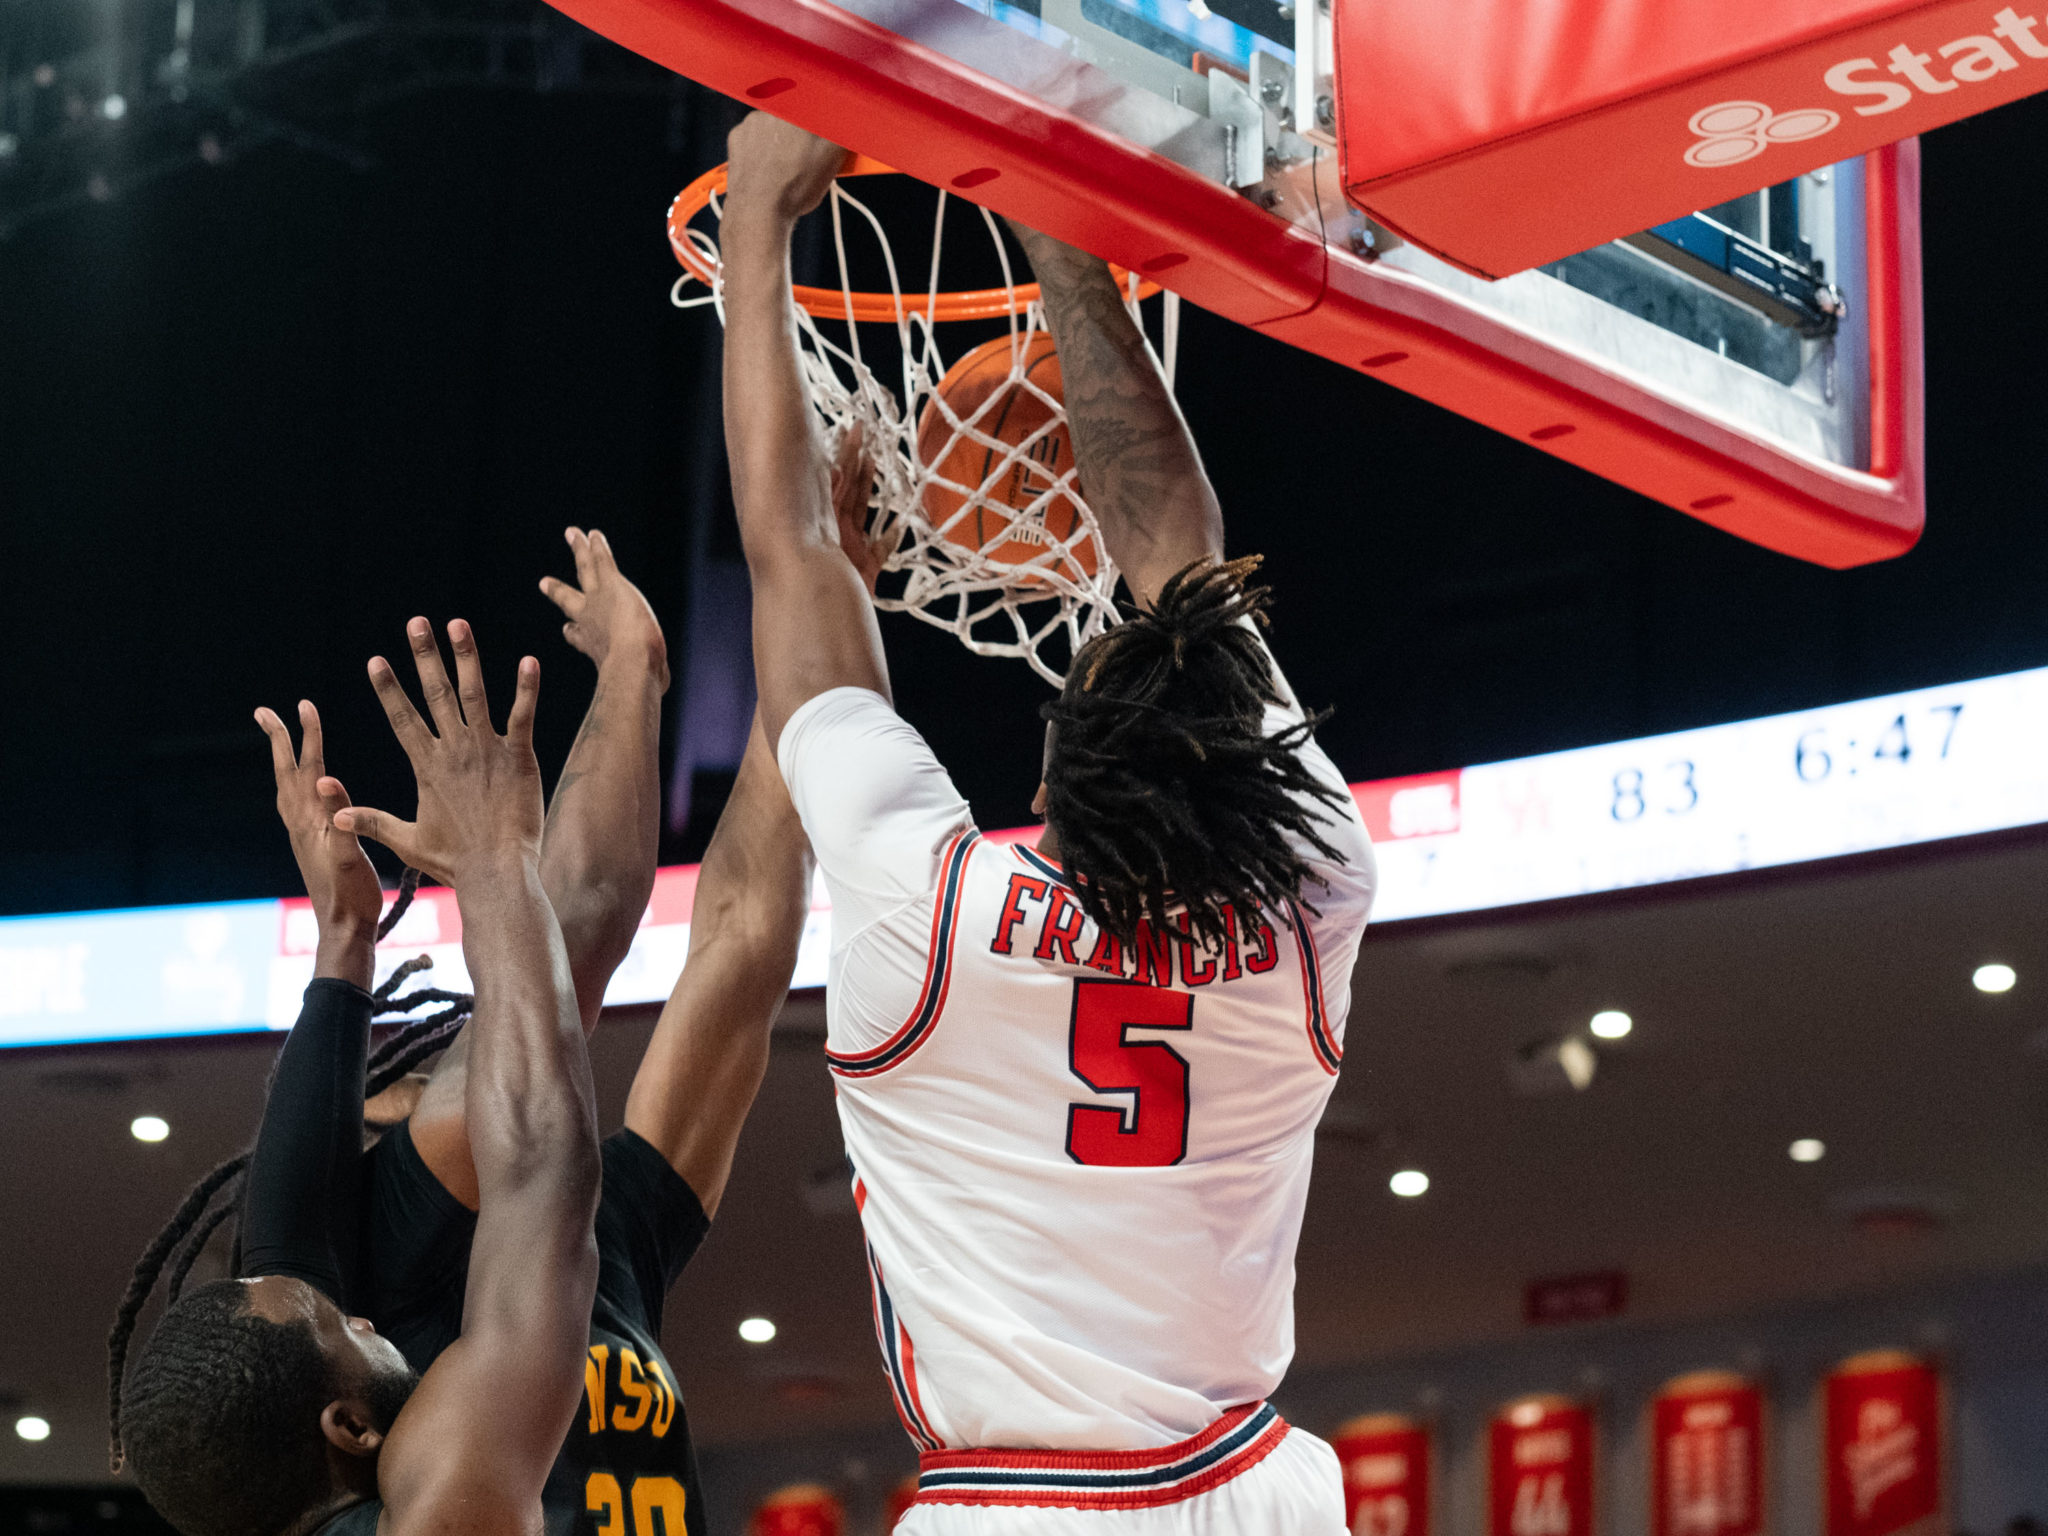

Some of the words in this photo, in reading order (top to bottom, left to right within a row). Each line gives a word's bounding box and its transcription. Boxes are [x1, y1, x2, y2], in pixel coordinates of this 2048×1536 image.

[1824, 7, 2048, 116] Stat
[1611, 760, 1698, 822] 83
[1795, 703, 1964, 784] 6:47
[1065, 976, 1195, 1168] 5
